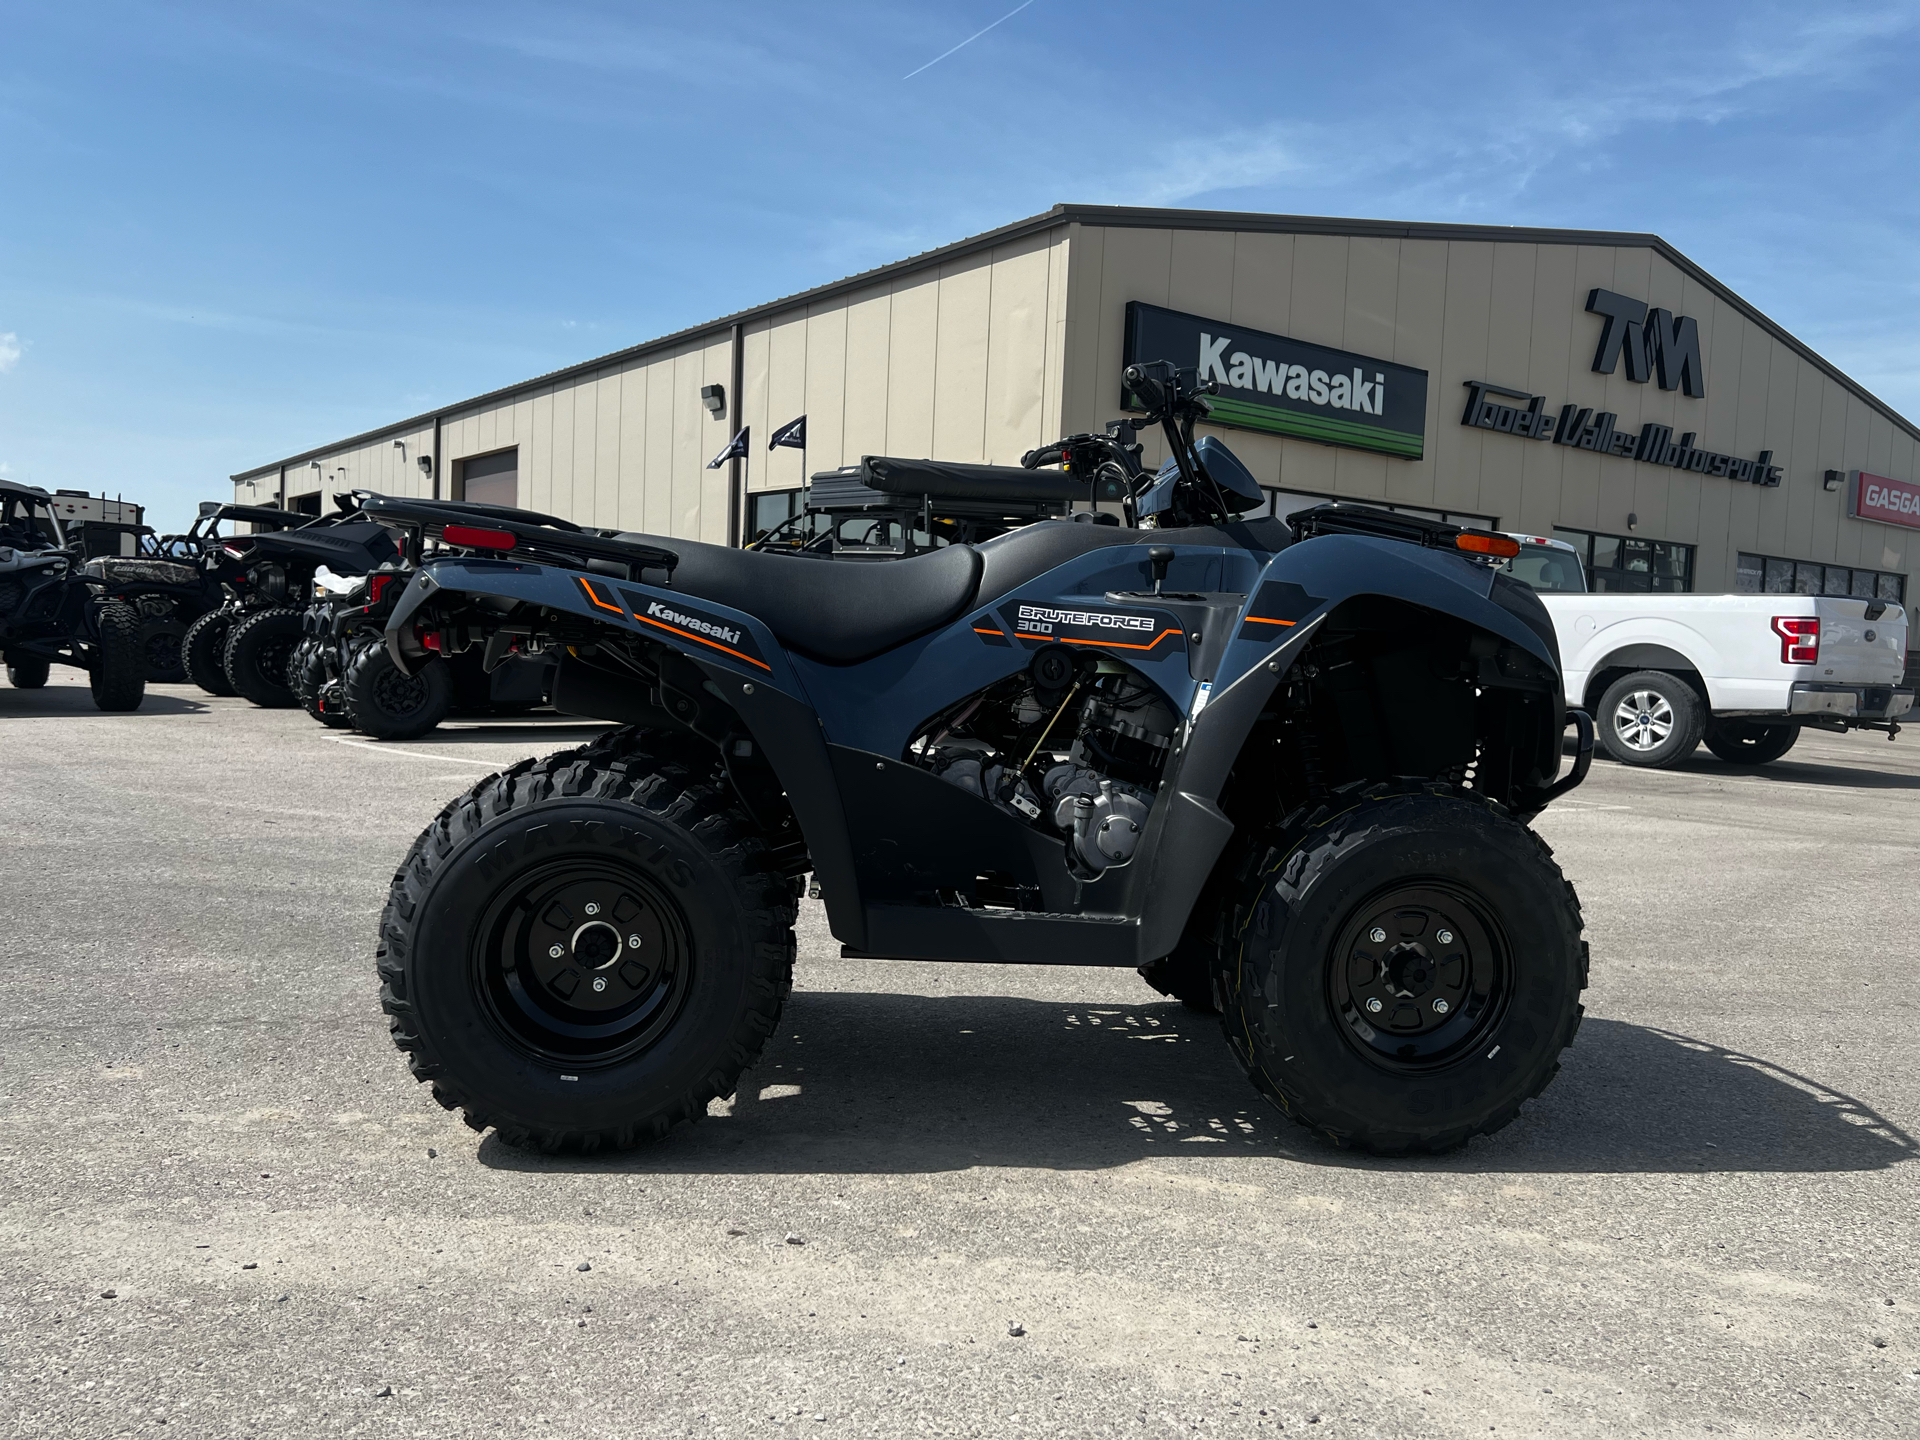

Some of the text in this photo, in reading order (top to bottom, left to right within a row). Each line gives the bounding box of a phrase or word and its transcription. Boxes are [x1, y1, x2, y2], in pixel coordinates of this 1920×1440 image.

[1200, 332, 1385, 416] Kawasaki
[1461, 380, 1784, 487] Tooele Valley Motorsports
[1865, 484, 1920, 516] GASGA
[647, 601, 742, 645] Kawasaki
[1017, 620, 1053, 633] 300
[473, 819, 699, 889] MAXXIS
[1406, 974, 1558, 1117] MAXXIS
